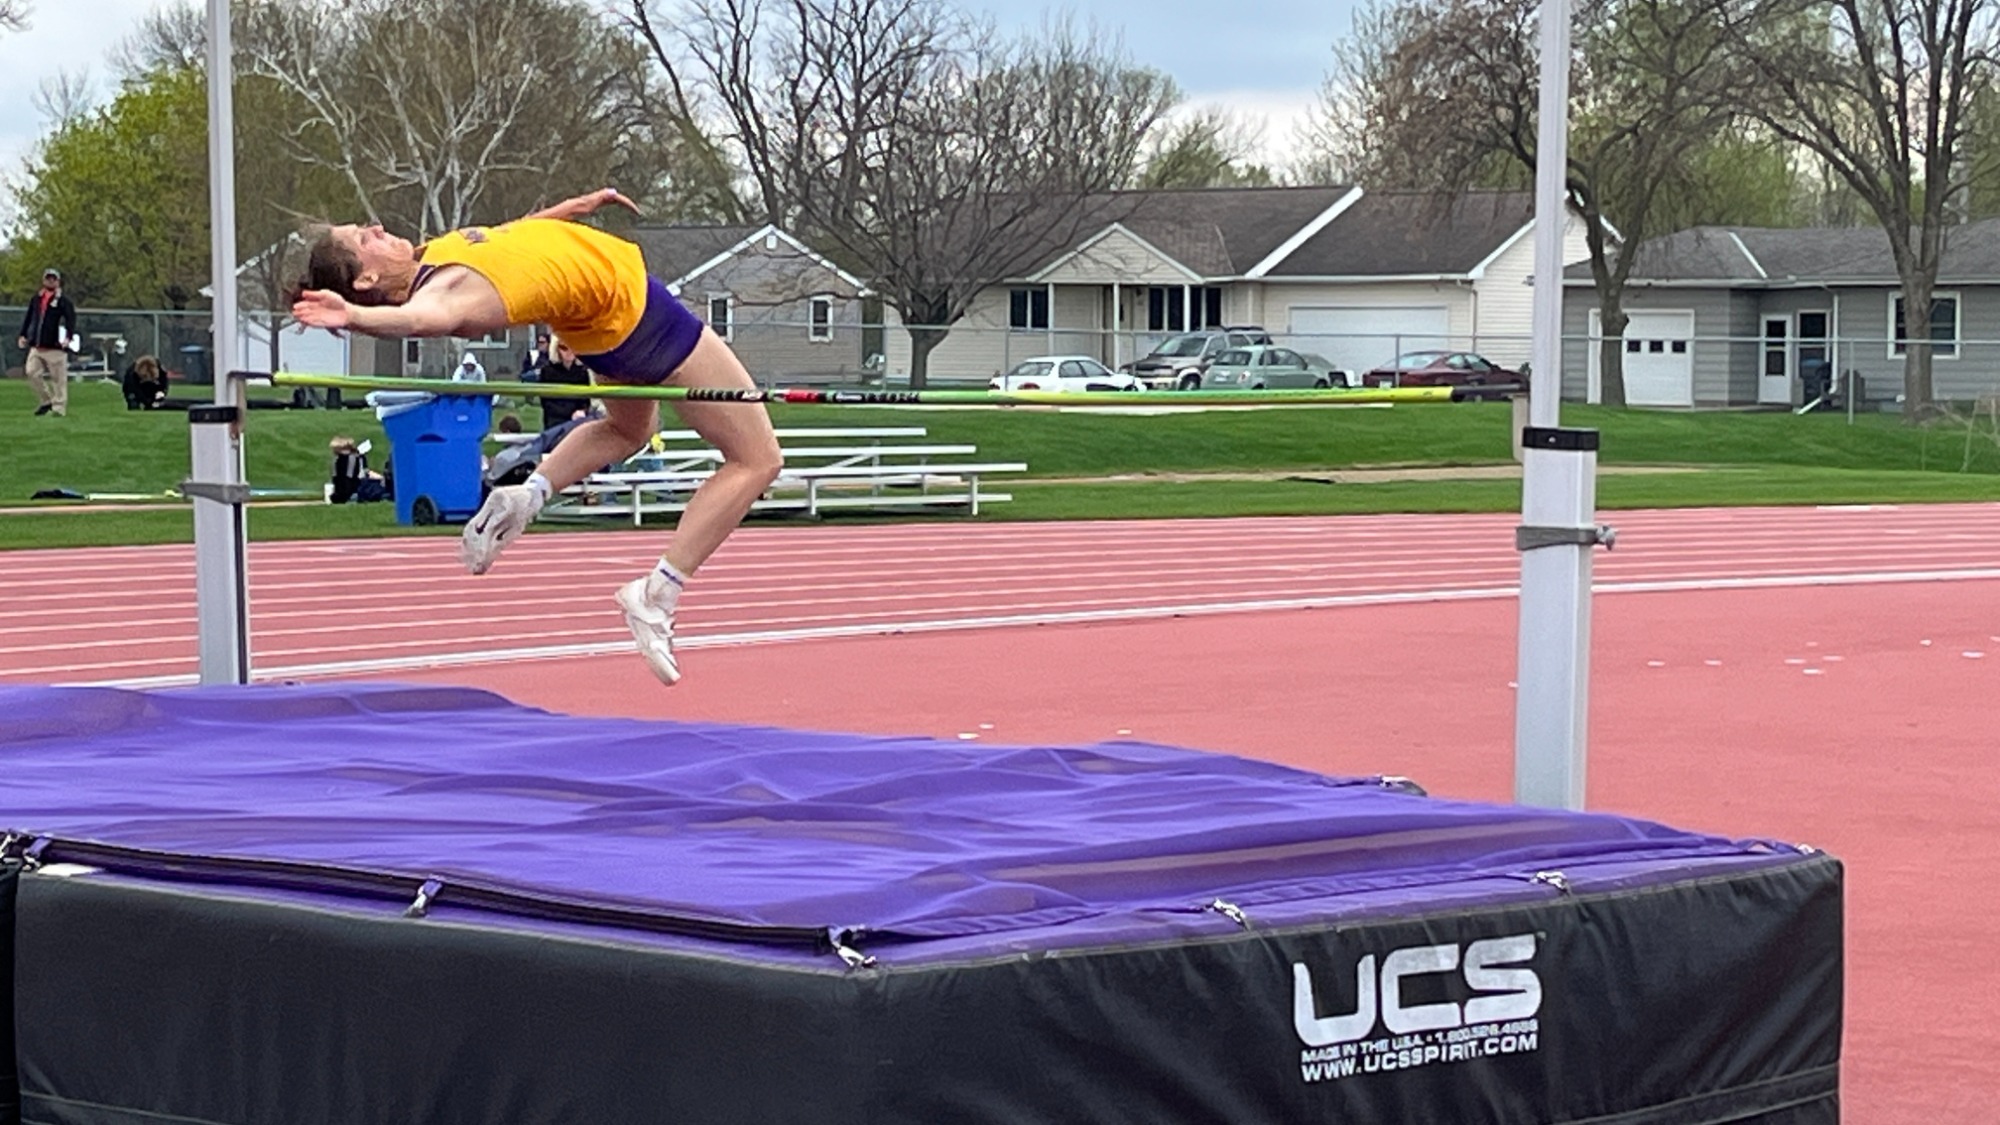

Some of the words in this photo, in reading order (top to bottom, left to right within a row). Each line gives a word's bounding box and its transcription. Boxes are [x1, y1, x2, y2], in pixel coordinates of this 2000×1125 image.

[1293, 934, 1542, 1047] UCS
[1301, 1046, 1340, 1063] MADE
[1342, 1043, 1358, 1057] IN
[1359, 1038, 1390, 1054] THE
[1301, 1033, 1538, 1082] WWW.UCSSPIRIT.COM
